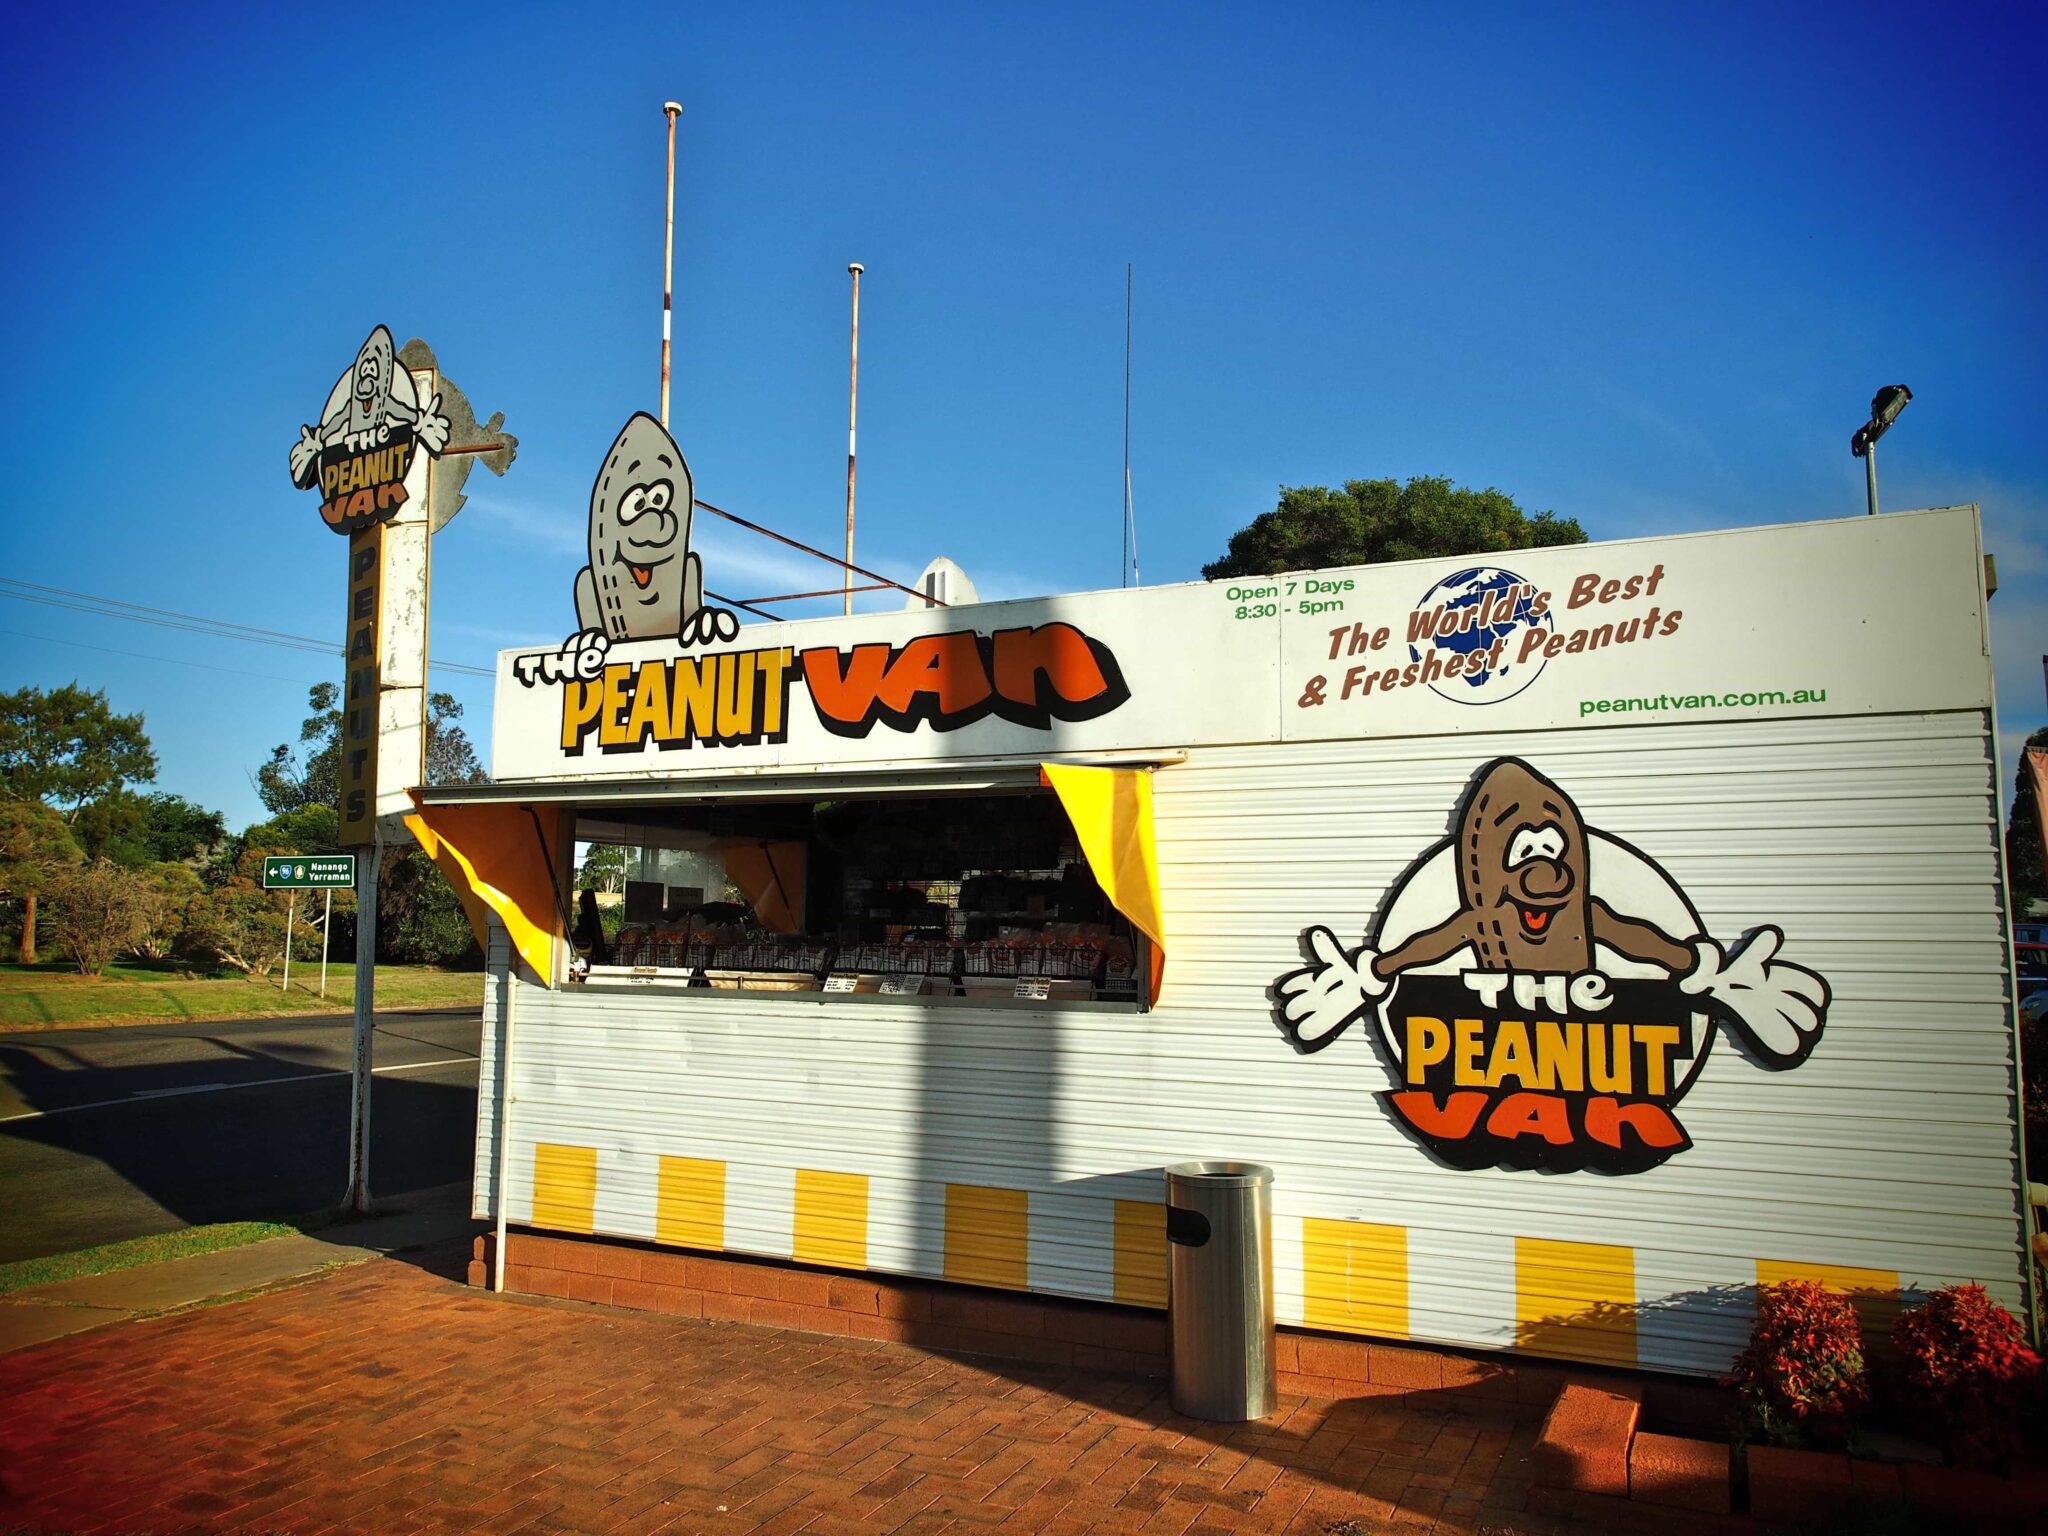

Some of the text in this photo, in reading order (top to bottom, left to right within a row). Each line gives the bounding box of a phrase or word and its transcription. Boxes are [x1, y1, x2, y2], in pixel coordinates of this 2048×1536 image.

[324, 443, 409, 499] PEANUT
[1226, 579, 1355, 602] Open 7 Days
[1235, 604, 1277, 620] 8:30
[1299, 600, 1344, 615] 5pm
[1328, 564, 1665, 660] The World's Best
[346, 548, 376, 822] PEANUTS
[1297, 607, 1683, 708] & Freshest Peanuts
[560, 646, 796, 750] PEANUT
[1580, 689, 1826, 717] peanutvan.com.au
[311, 863, 348, 872] Nanango
[1406, 1016, 1680, 1096] PEANUT
